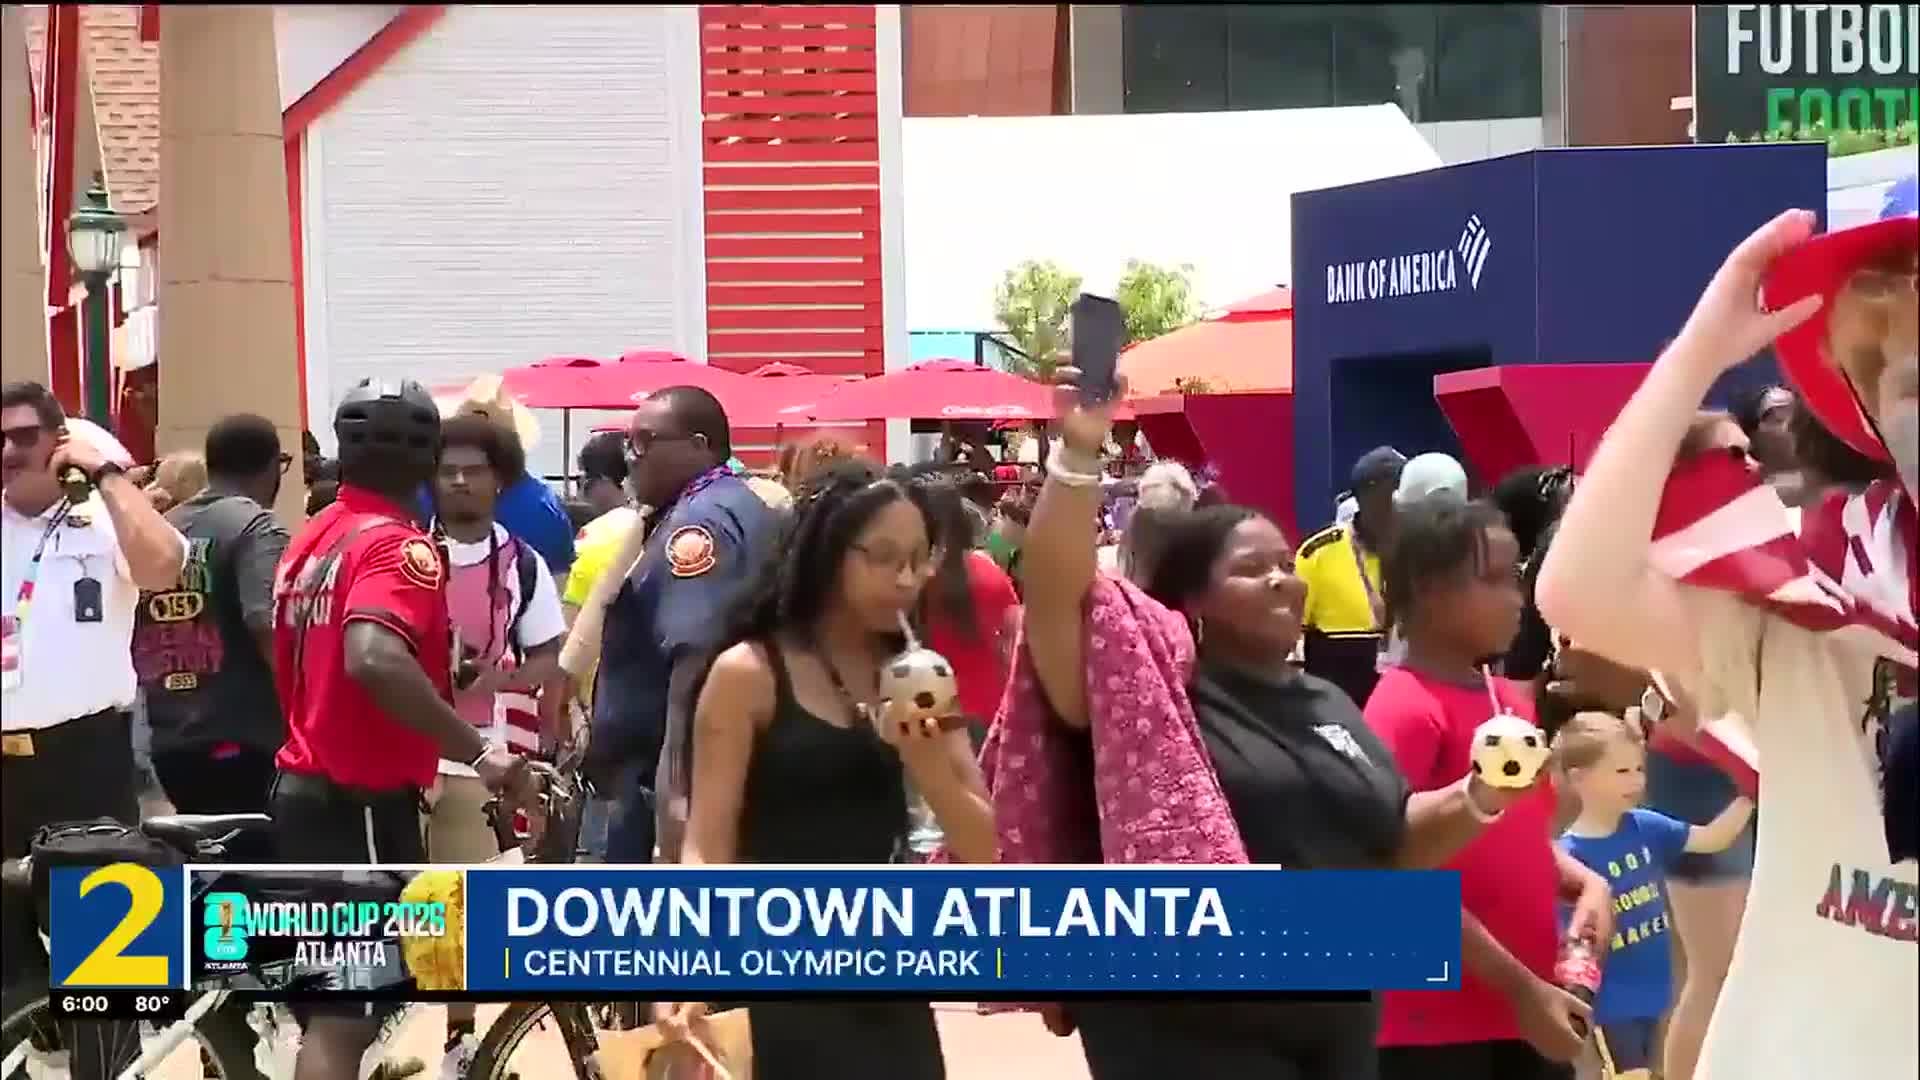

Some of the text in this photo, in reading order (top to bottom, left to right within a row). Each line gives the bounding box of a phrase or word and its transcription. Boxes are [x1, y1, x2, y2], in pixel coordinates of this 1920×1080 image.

[1767, 87, 1918, 132] FOOT
[1327, 249, 1457, 303] BANK OF AMERICA
